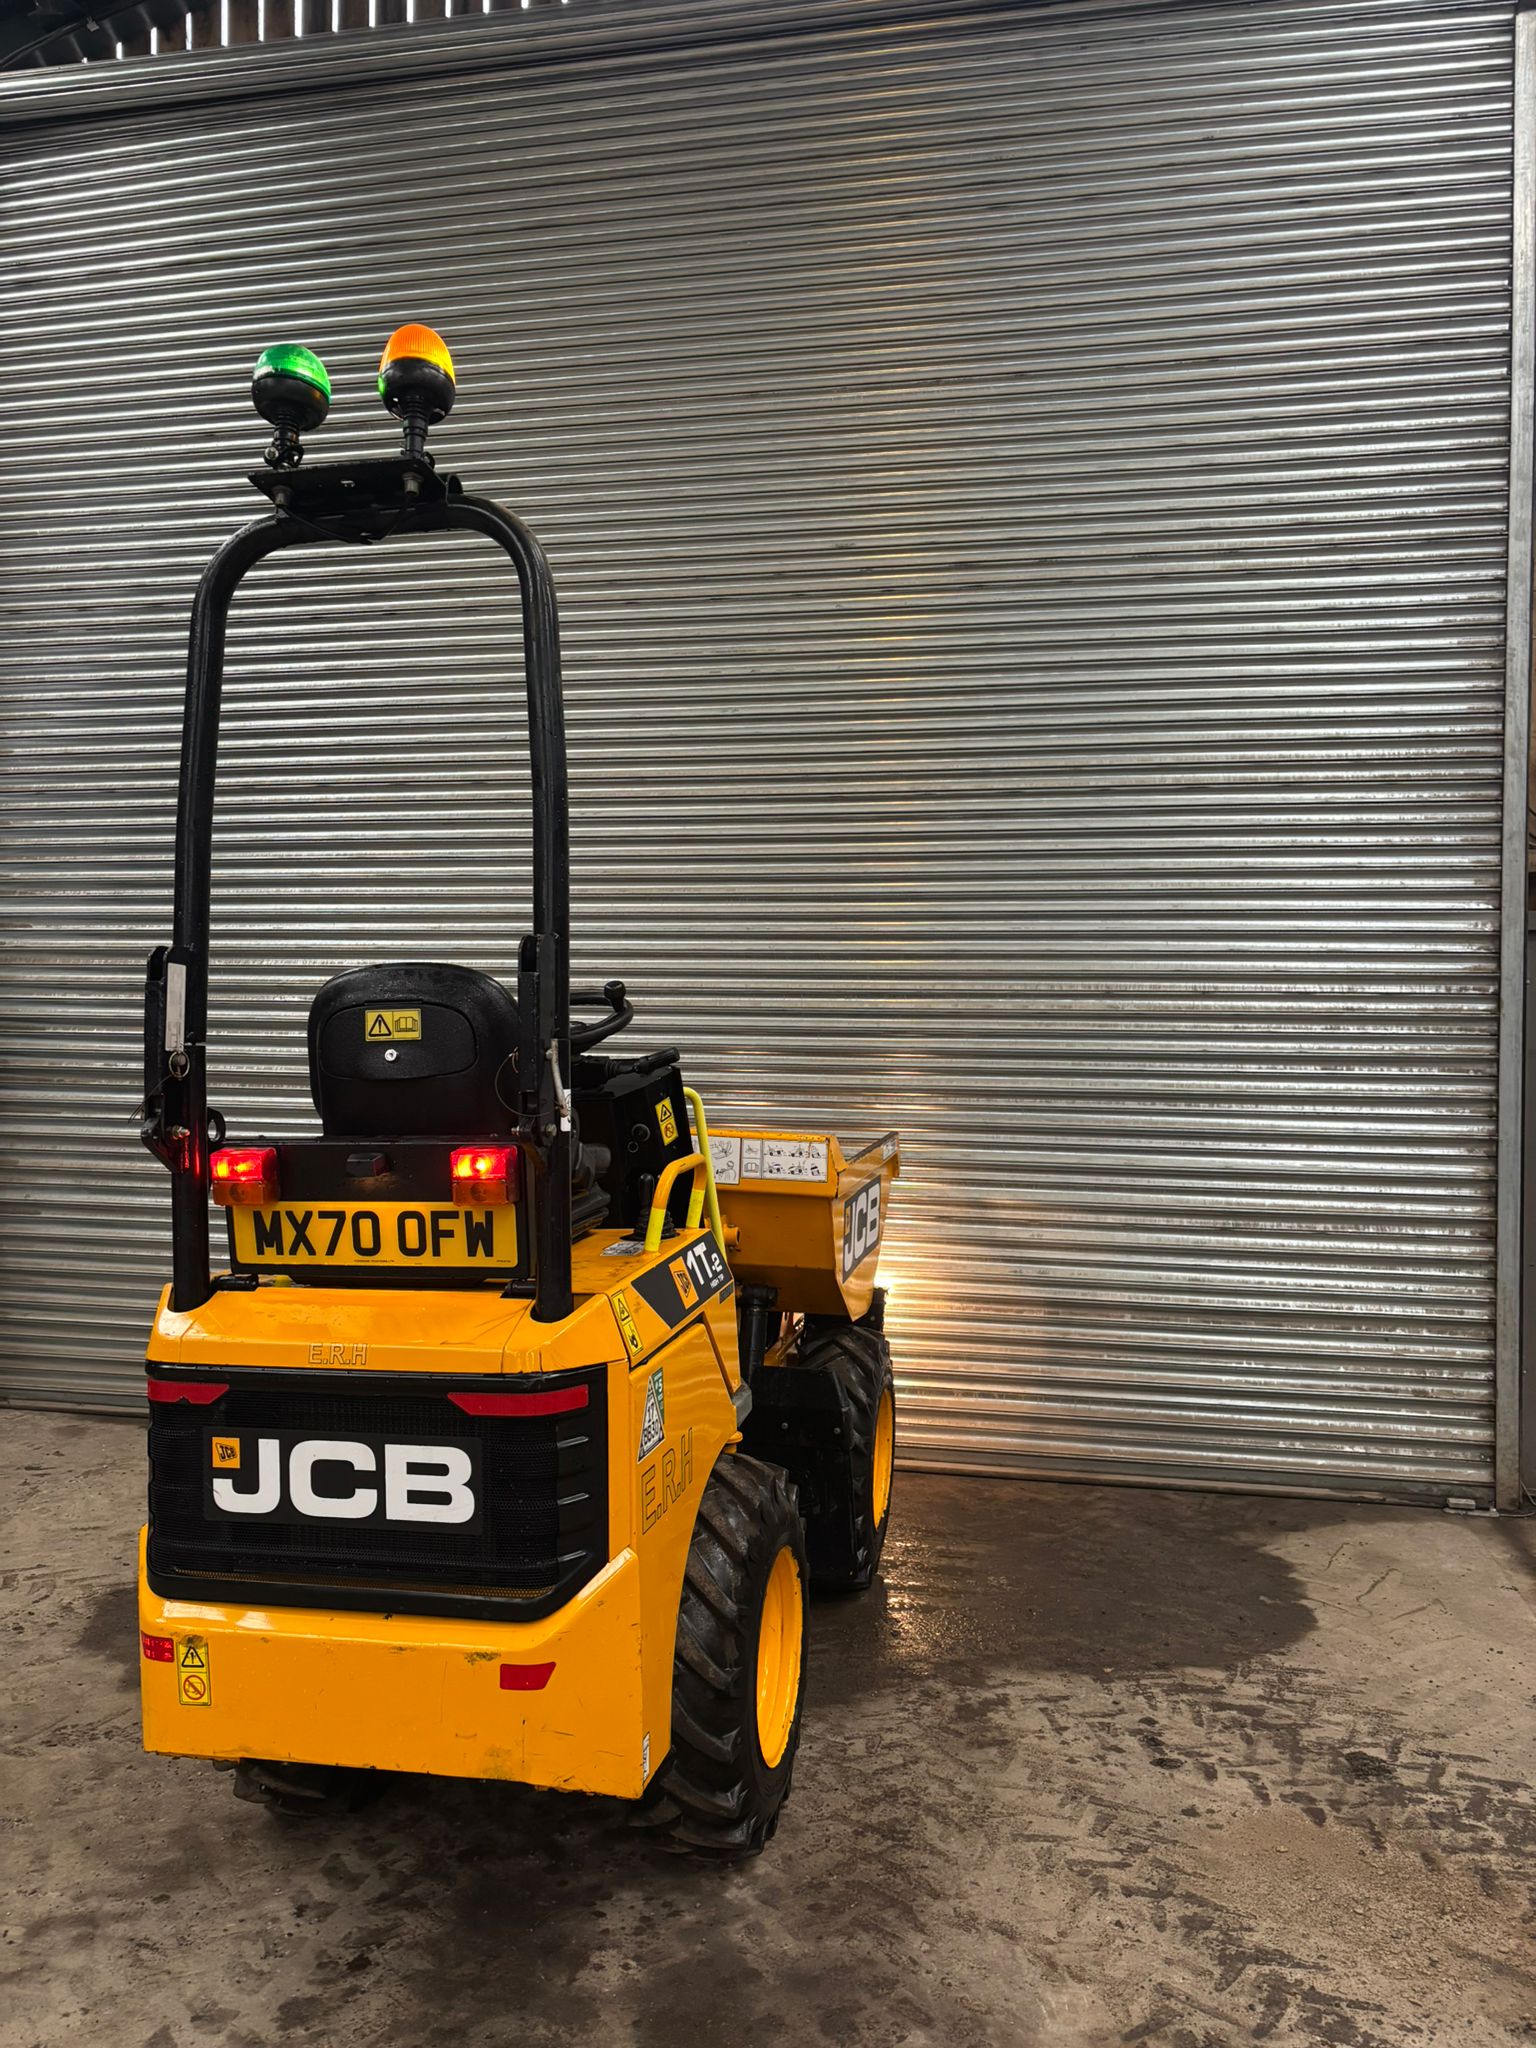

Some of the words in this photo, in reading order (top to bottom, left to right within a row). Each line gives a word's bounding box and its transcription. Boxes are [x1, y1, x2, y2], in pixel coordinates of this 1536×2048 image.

[253, 1210, 382, 1257] MX70
[397, 1211, 494, 1258] OFW
[845, 1183, 880, 1272] JCB
[308, 1343, 368, 1366] E.R.H
[212, 1438, 475, 1524] JCB
[218, 1444, 237, 1461] JCB
[641, 1426, 693, 1536] E.R.H
